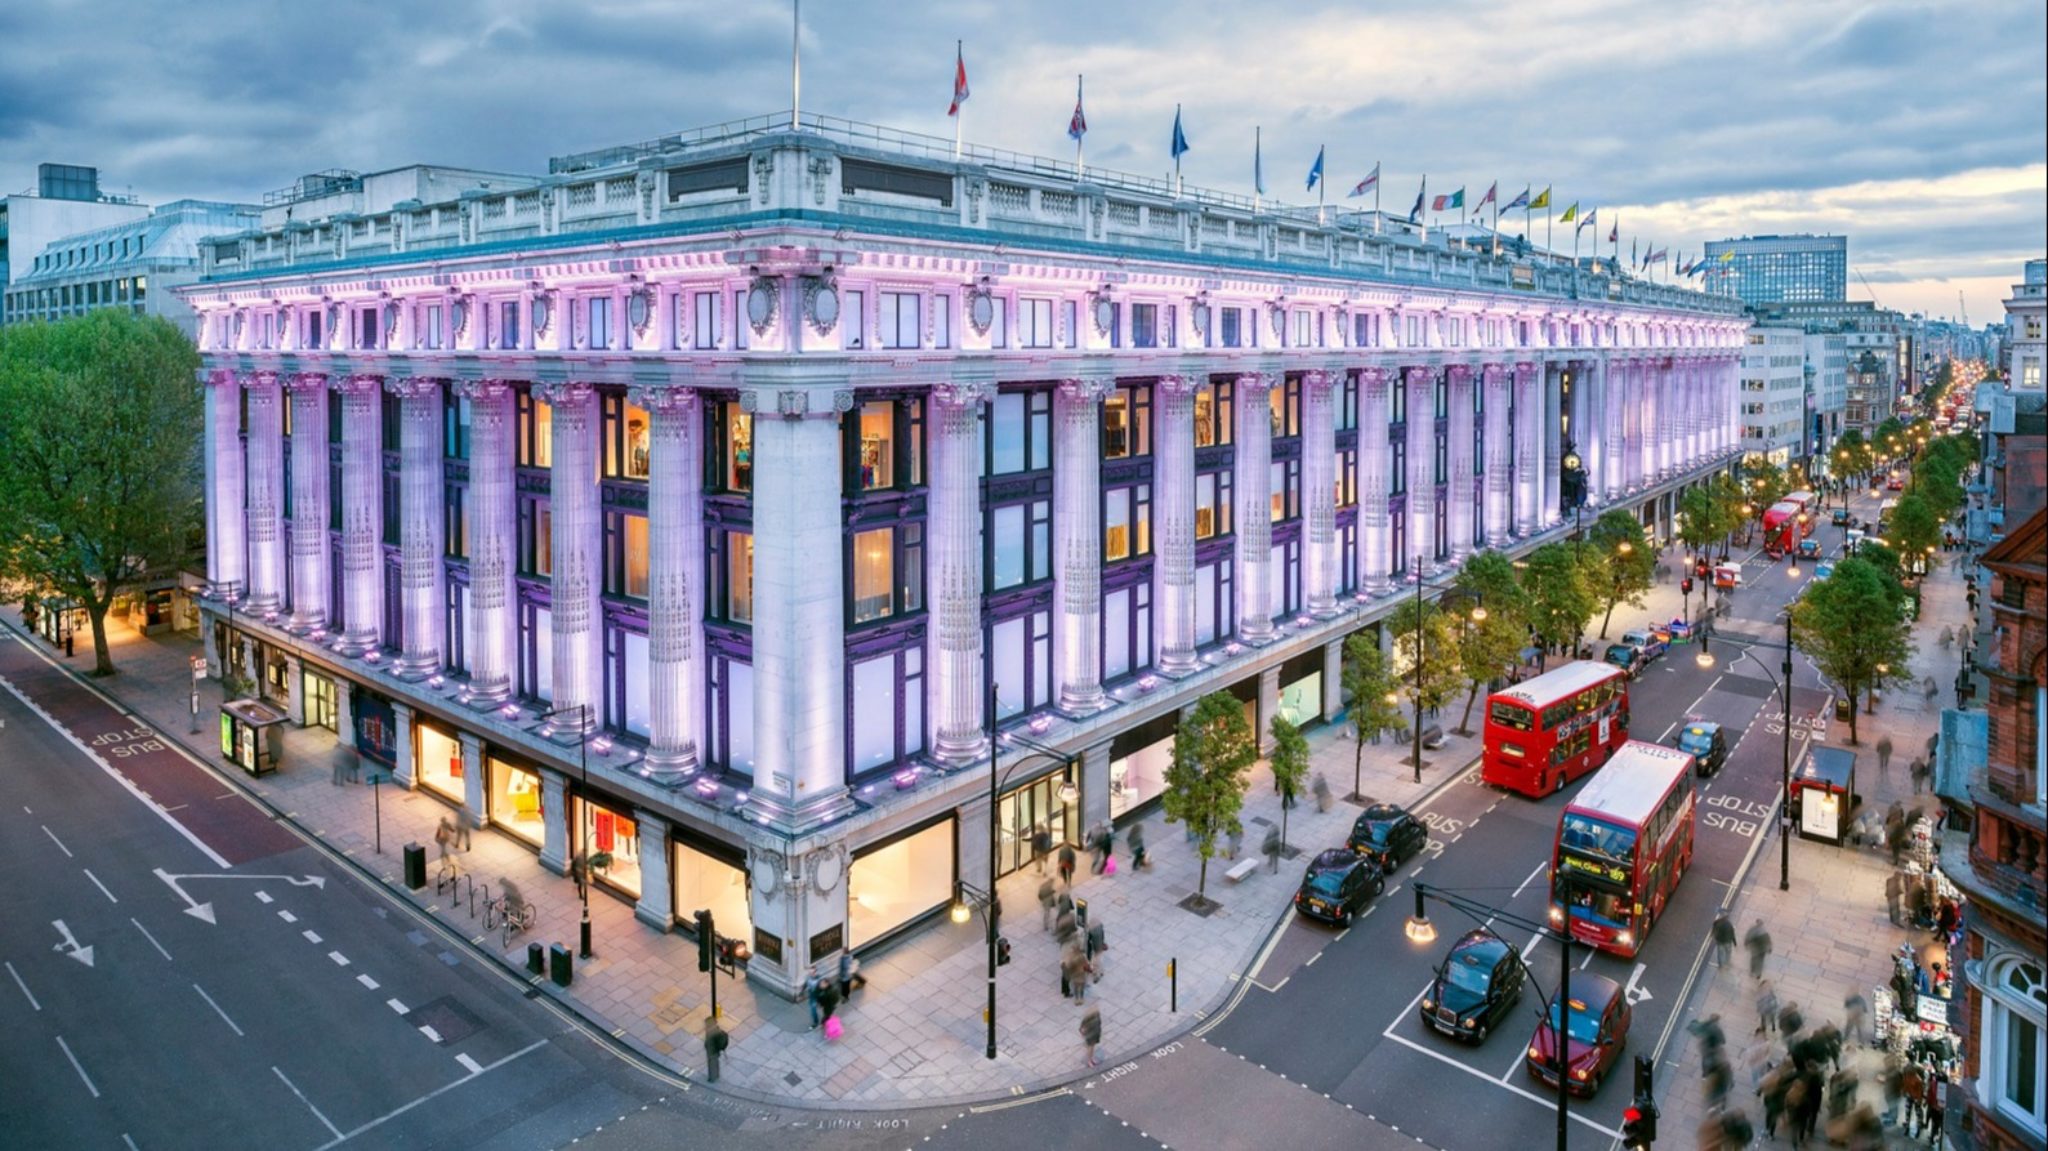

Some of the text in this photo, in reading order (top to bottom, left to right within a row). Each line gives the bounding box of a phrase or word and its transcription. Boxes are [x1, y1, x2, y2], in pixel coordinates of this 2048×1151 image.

[92, 727, 153, 746] STOP
[112, 740, 165, 758] BUS
[1707, 794, 1770, 818] STOP
[1703, 812, 1757, 837] BUS
[1101, 1041, 1184, 1083] LOOK RIGHT
[874, 1119, 909, 1129] LOOK
